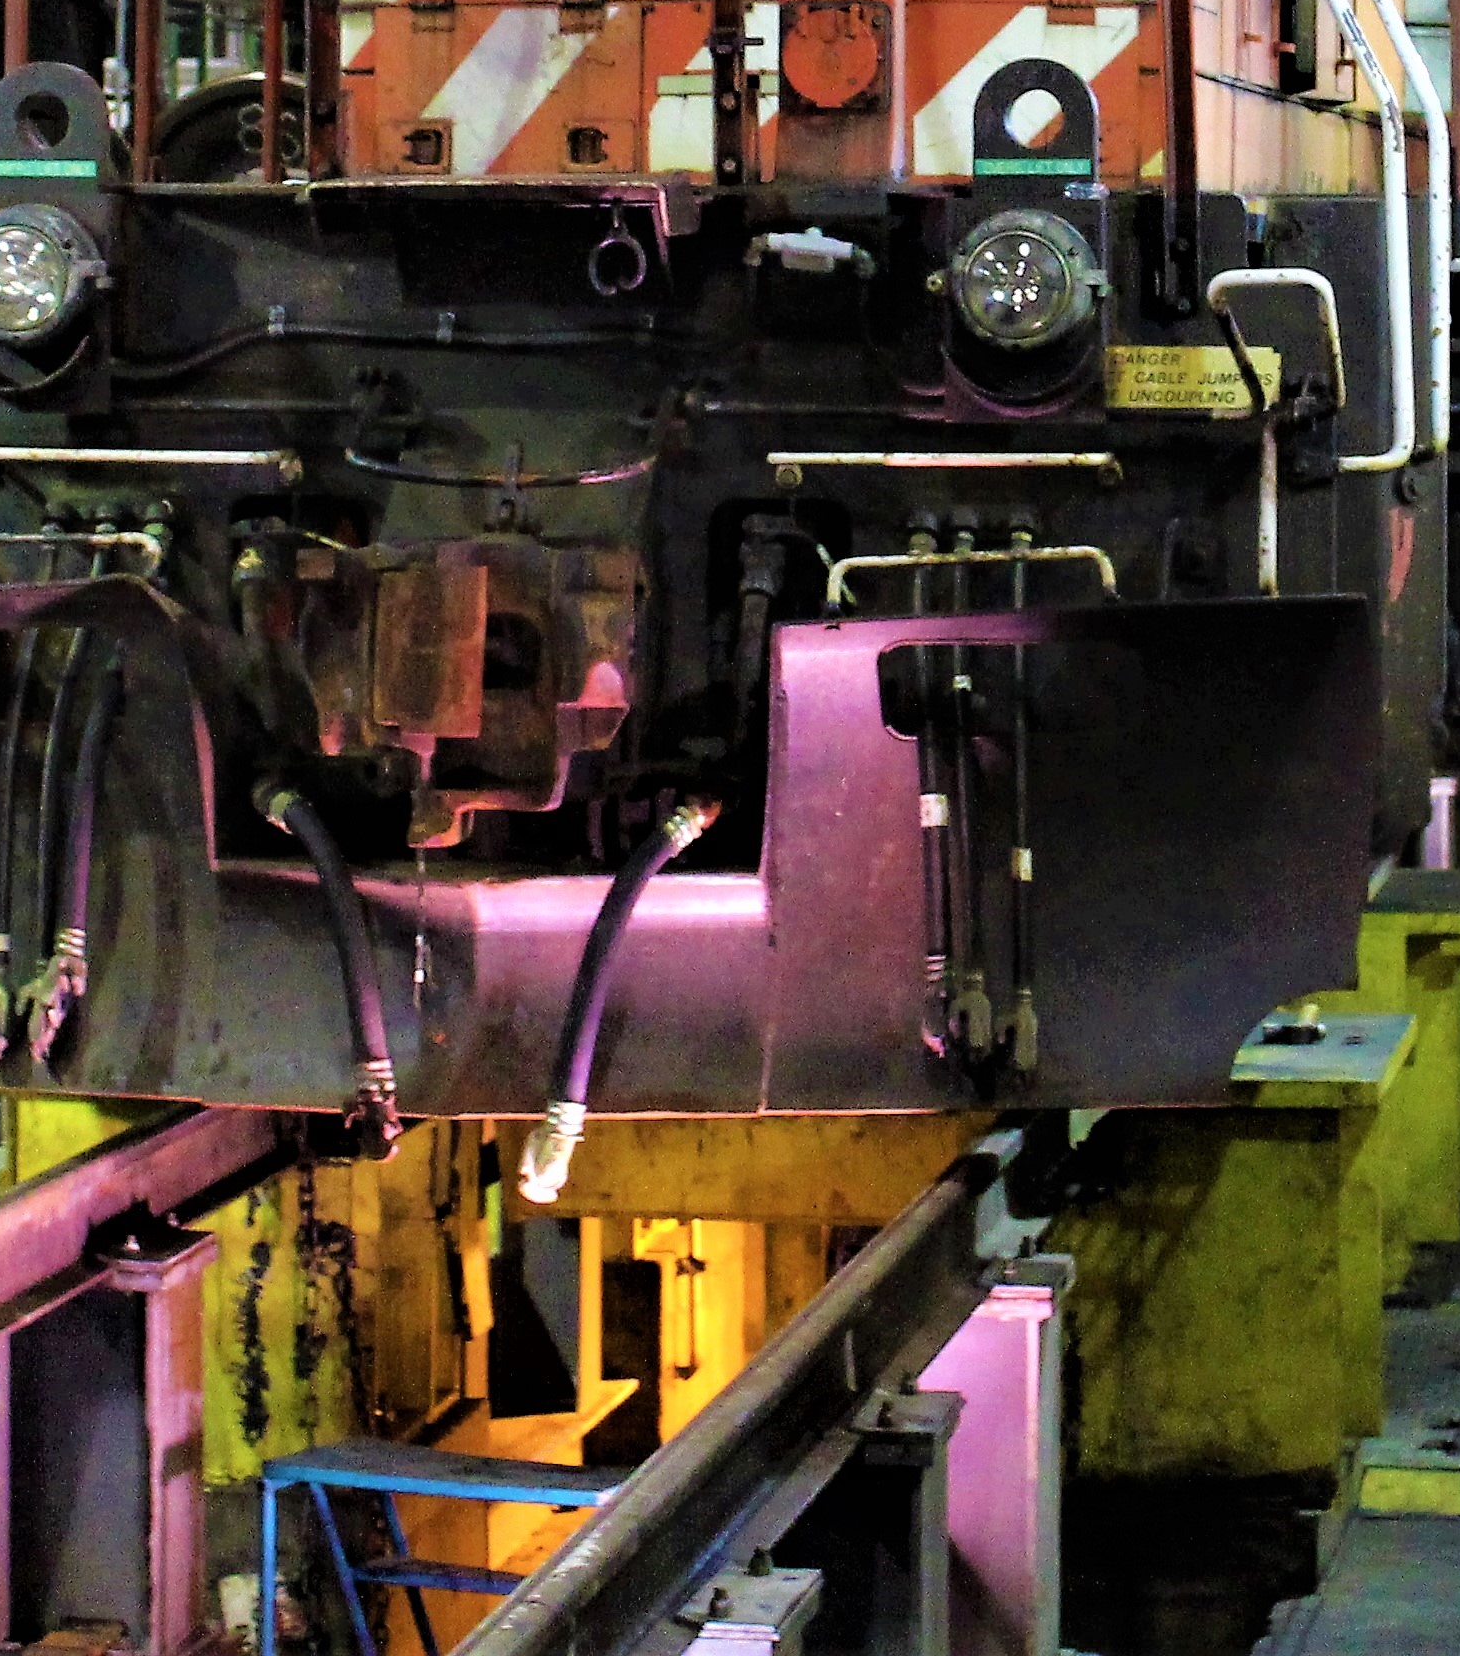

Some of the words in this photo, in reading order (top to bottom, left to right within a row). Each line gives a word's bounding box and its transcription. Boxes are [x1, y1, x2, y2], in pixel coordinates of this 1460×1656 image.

[1135, 371, 1187, 384] CABLE
[1197, 371, 1273, 385] JUMPS
[1129, 389, 1236, 404] UNCOUPLING
